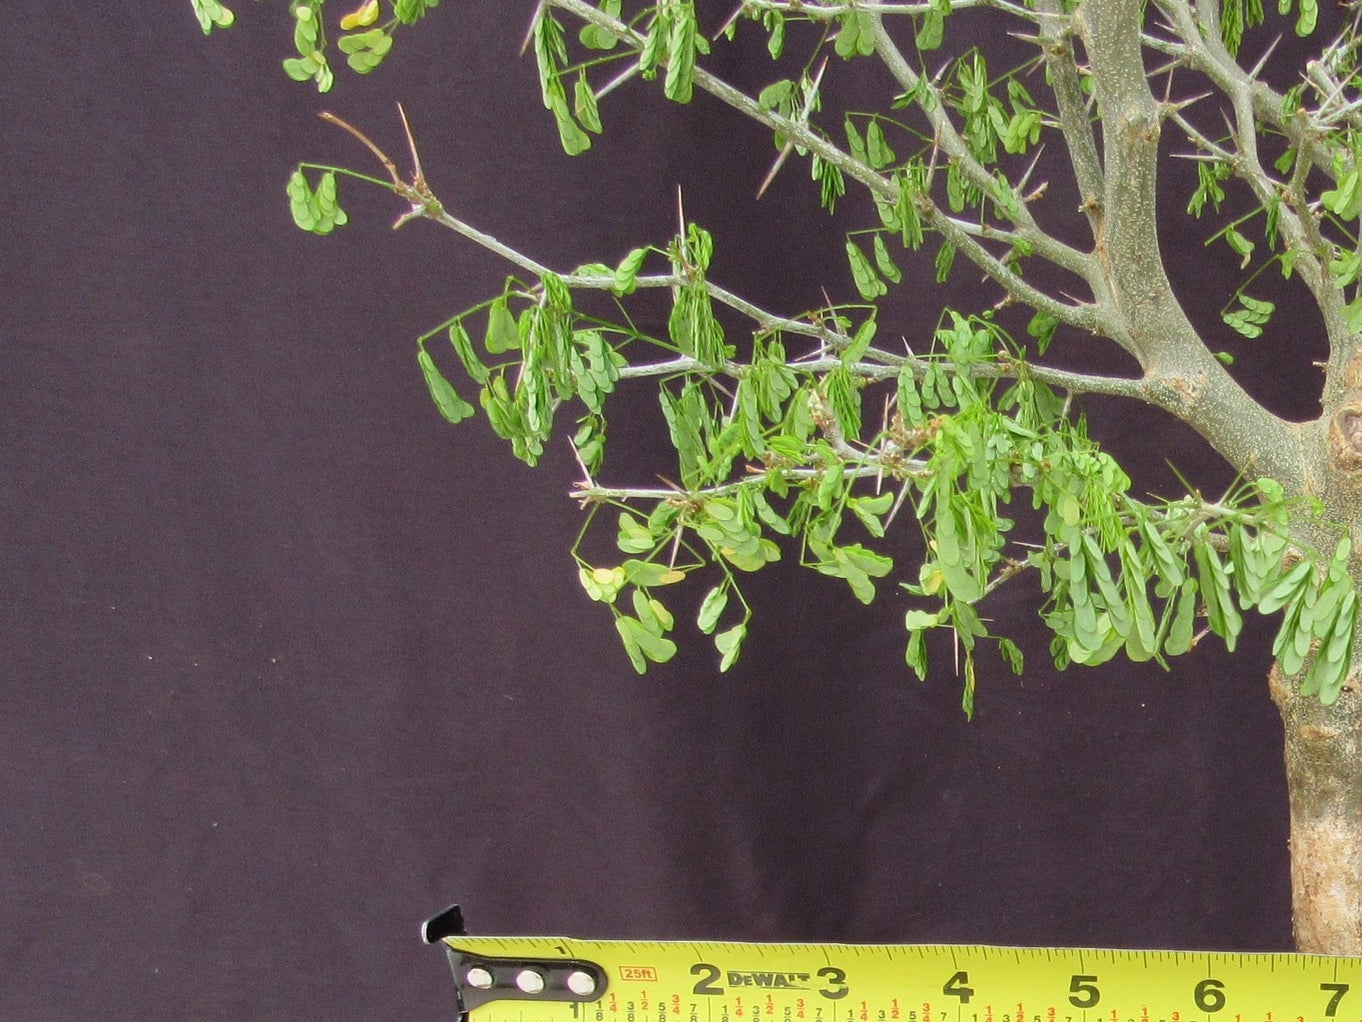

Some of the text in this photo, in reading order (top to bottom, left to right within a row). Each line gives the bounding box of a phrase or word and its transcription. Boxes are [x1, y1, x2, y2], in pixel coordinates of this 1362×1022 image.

[625, 969, 653, 979] 25ft
[690, 963, 725, 996] 2
[817, 967, 849, 1000] 3
[943, 971, 975, 1004] 4
[1068, 975, 1100, 1008] 5
[1194, 979, 1226, 1013] 6
[1320, 983, 1350, 1017] 7
[569, 1002, 579, 1019] 1
